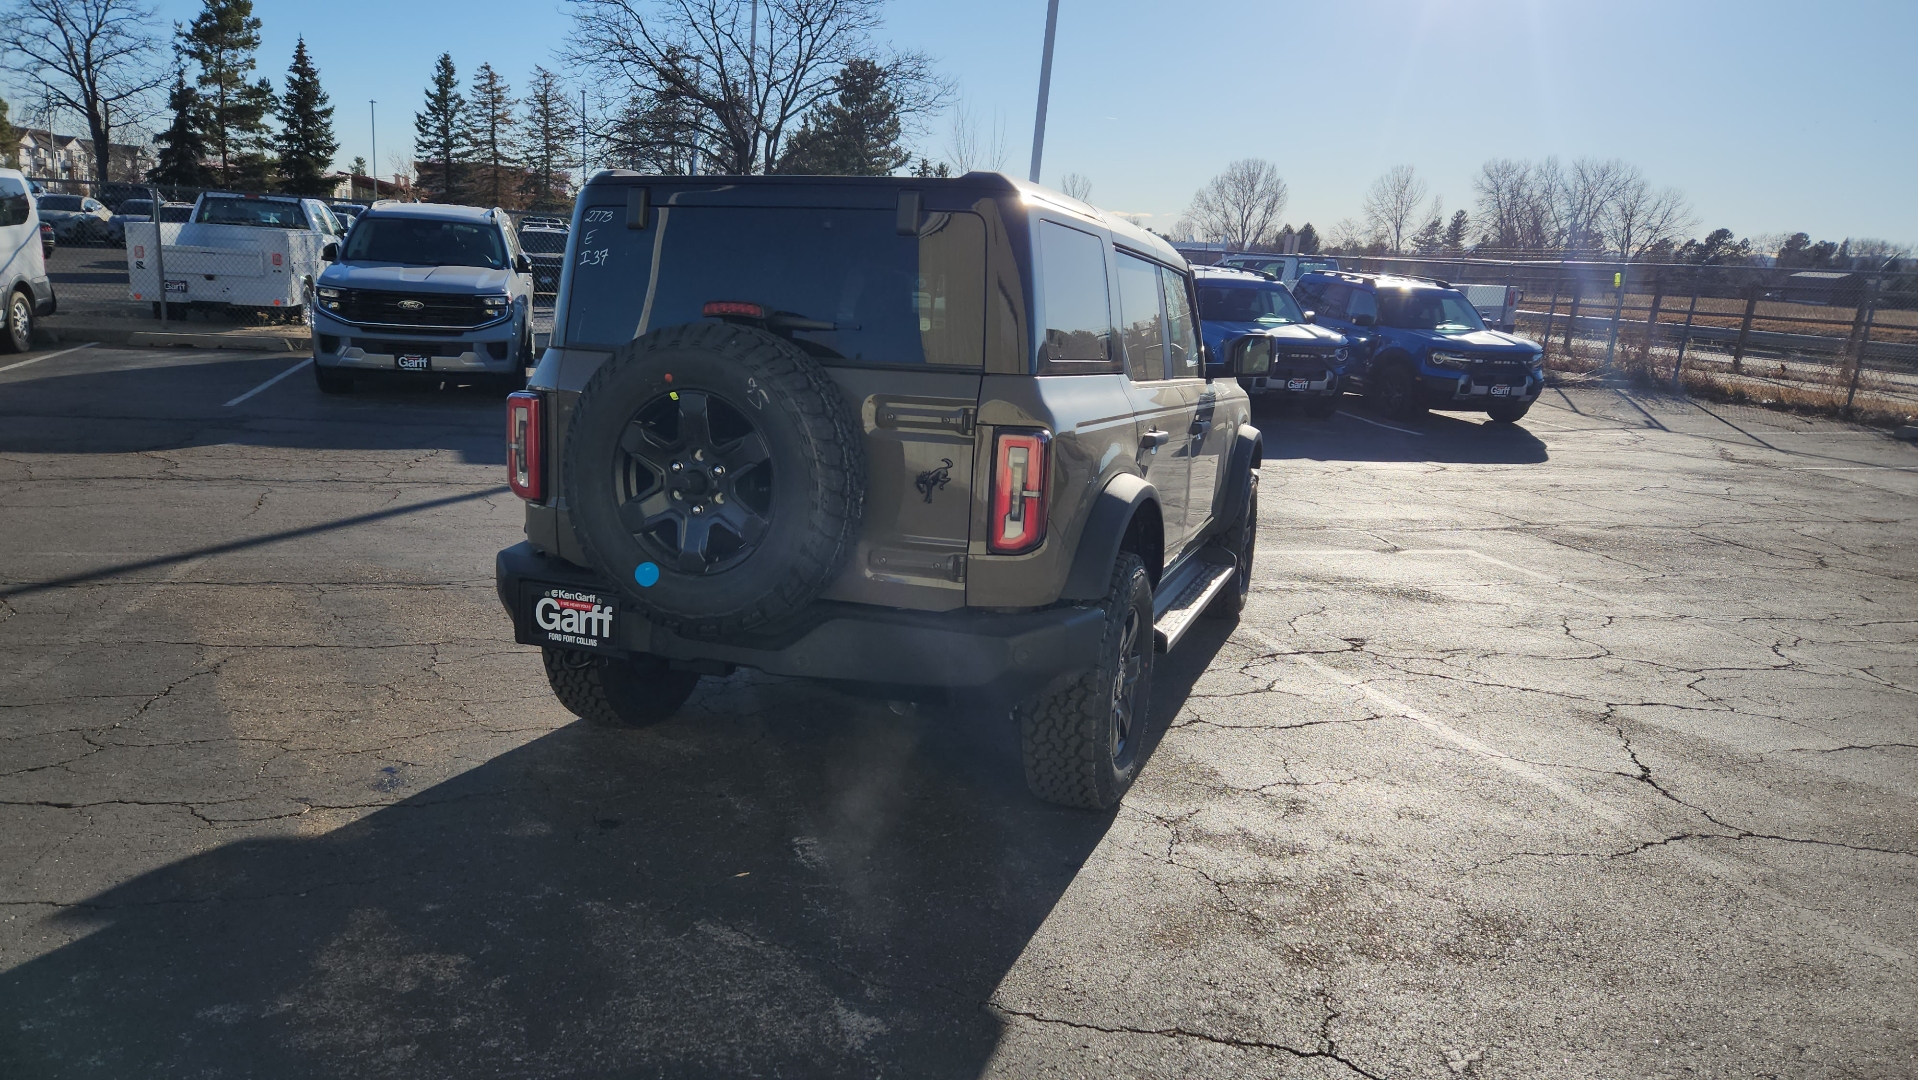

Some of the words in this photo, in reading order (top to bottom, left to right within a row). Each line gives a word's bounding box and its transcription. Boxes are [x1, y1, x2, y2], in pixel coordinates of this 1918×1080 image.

[584, 210, 614, 223] 2773
[584, 229, 598, 245] E
[400, 301, 421, 309] Ford
[398, 356, 428, 368] Garff
[1287, 380, 1309, 389] Garff
[1490, 385, 1511, 396] Garff
[558, 590, 575, 600] Ken
[575, 592, 596, 603] Garff
[535, 597, 613, 638] Garff
[548, 632, 562, 642] FORD
[562, 634, 576, 644] FORT
[576, 636, 598, 647] COLLINS
